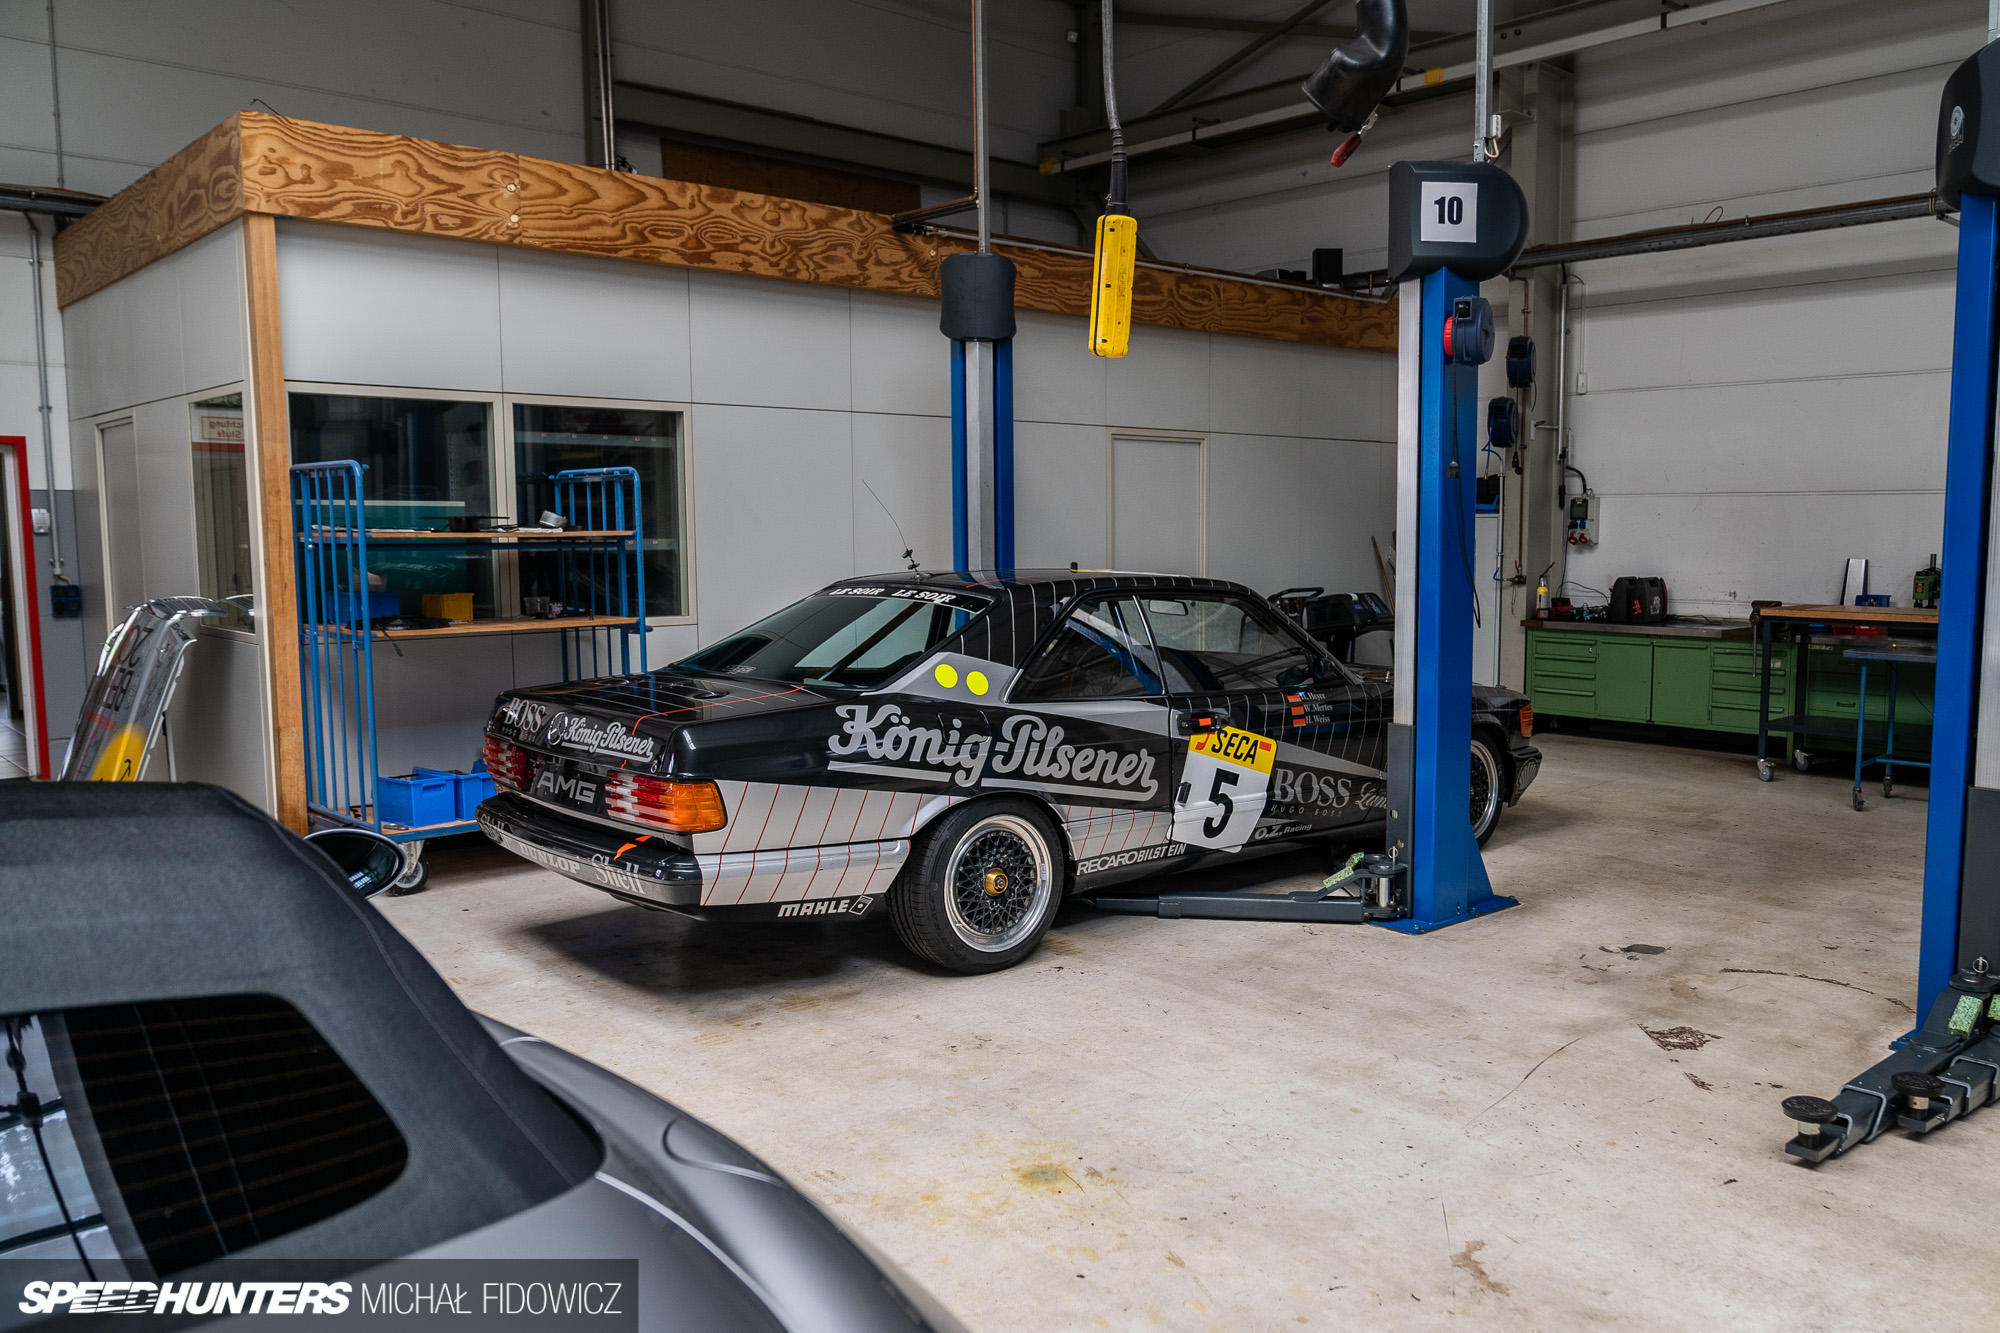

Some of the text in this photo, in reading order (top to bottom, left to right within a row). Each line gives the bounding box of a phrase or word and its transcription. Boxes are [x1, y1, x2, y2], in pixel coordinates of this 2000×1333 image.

[1434, 196, 1464, 225] 10
[891, 589, 957, 604] LE SOIR
[503, 697, 546, 733] BOSS
[1211, 729, 1259, 765] SECA
[537, 771, 597, 804] AMG
[1273, 767, 1352, 808] BOSS
[1202, 767, 1240, 840] 5
[1271, 804, 1305, 814] HUGO
[1283, 823, 1313, 834] Racing
[519, 842, 582, 875] DUNLOP
[1076, 850, 1138, 876] RECARO
[1136, 843, 1188, 863] BILSTEIN
[591, 853, 647, 895] Shell
[777, 899, 851, 918] MAHLE
